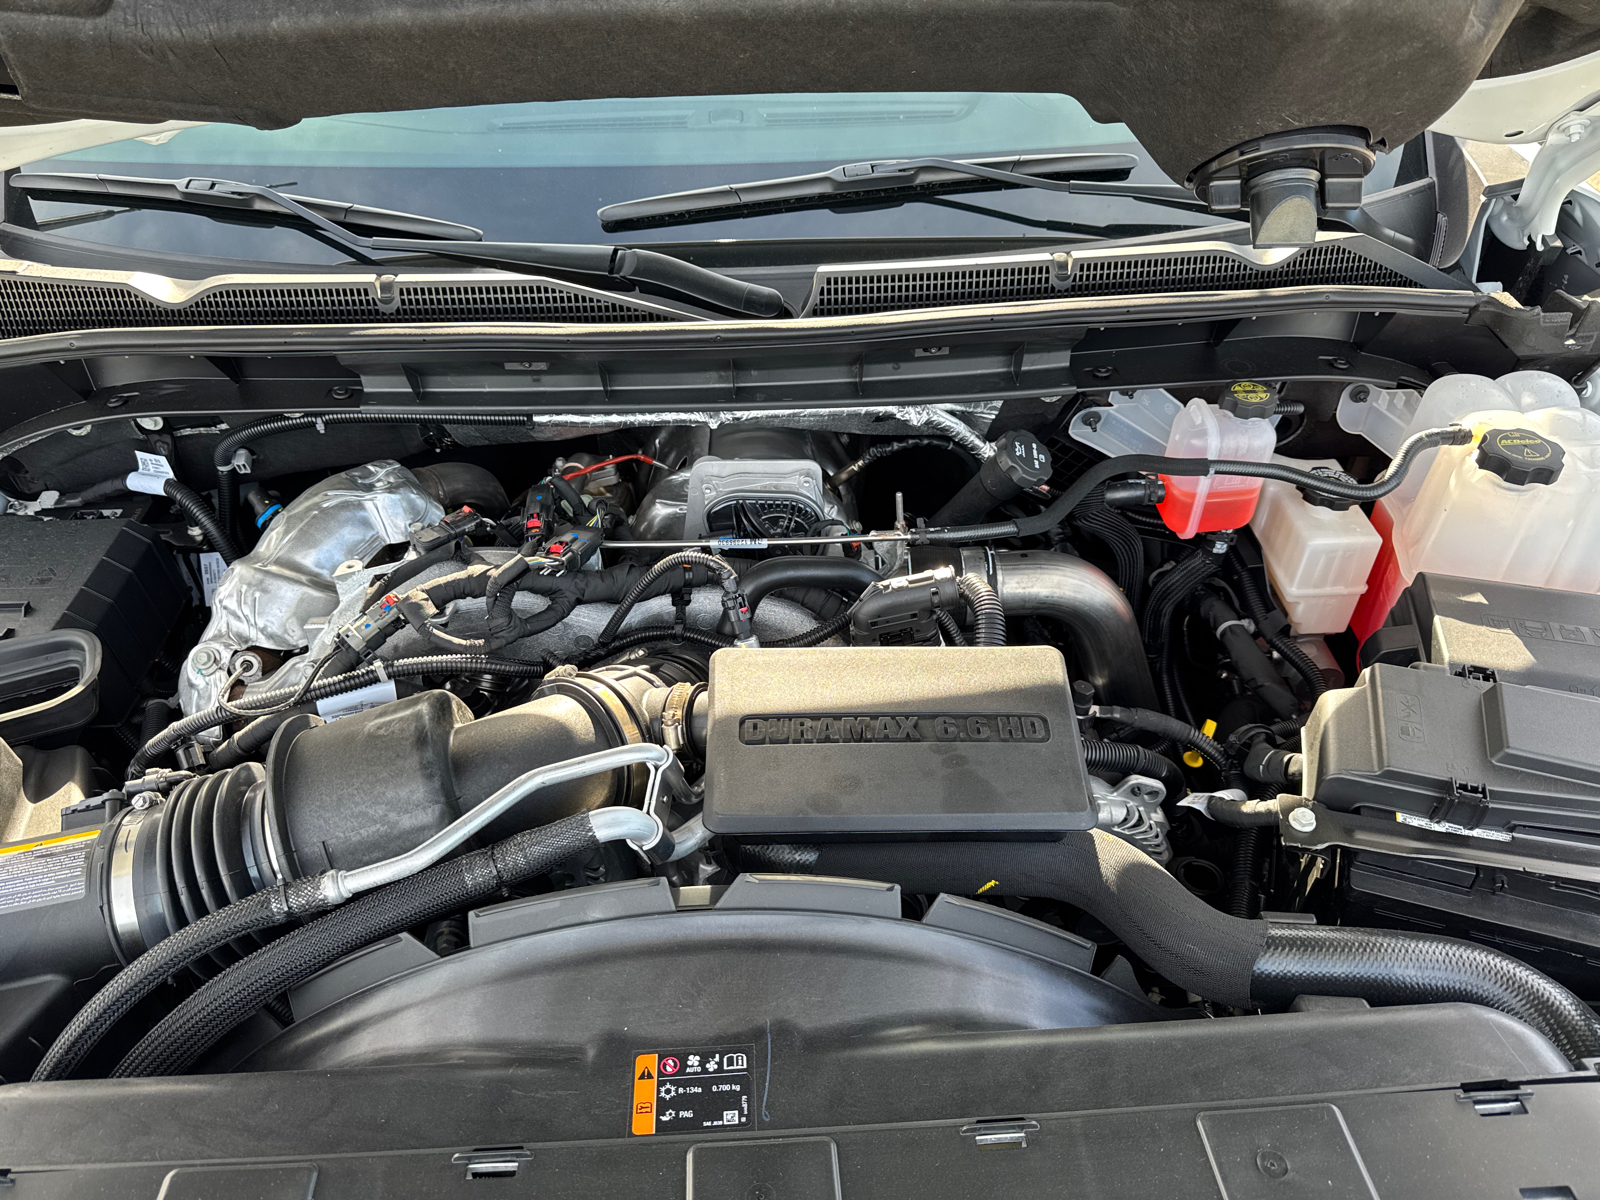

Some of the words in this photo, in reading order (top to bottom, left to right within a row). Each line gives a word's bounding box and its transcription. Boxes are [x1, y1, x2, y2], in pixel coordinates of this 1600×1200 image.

[744, 716, 921, 742] DURAMAX
[934, 716, 990, 739] 6.6
[999, 716, 1046, 739] HD
[679, 1110, 693, 1118] PAG
